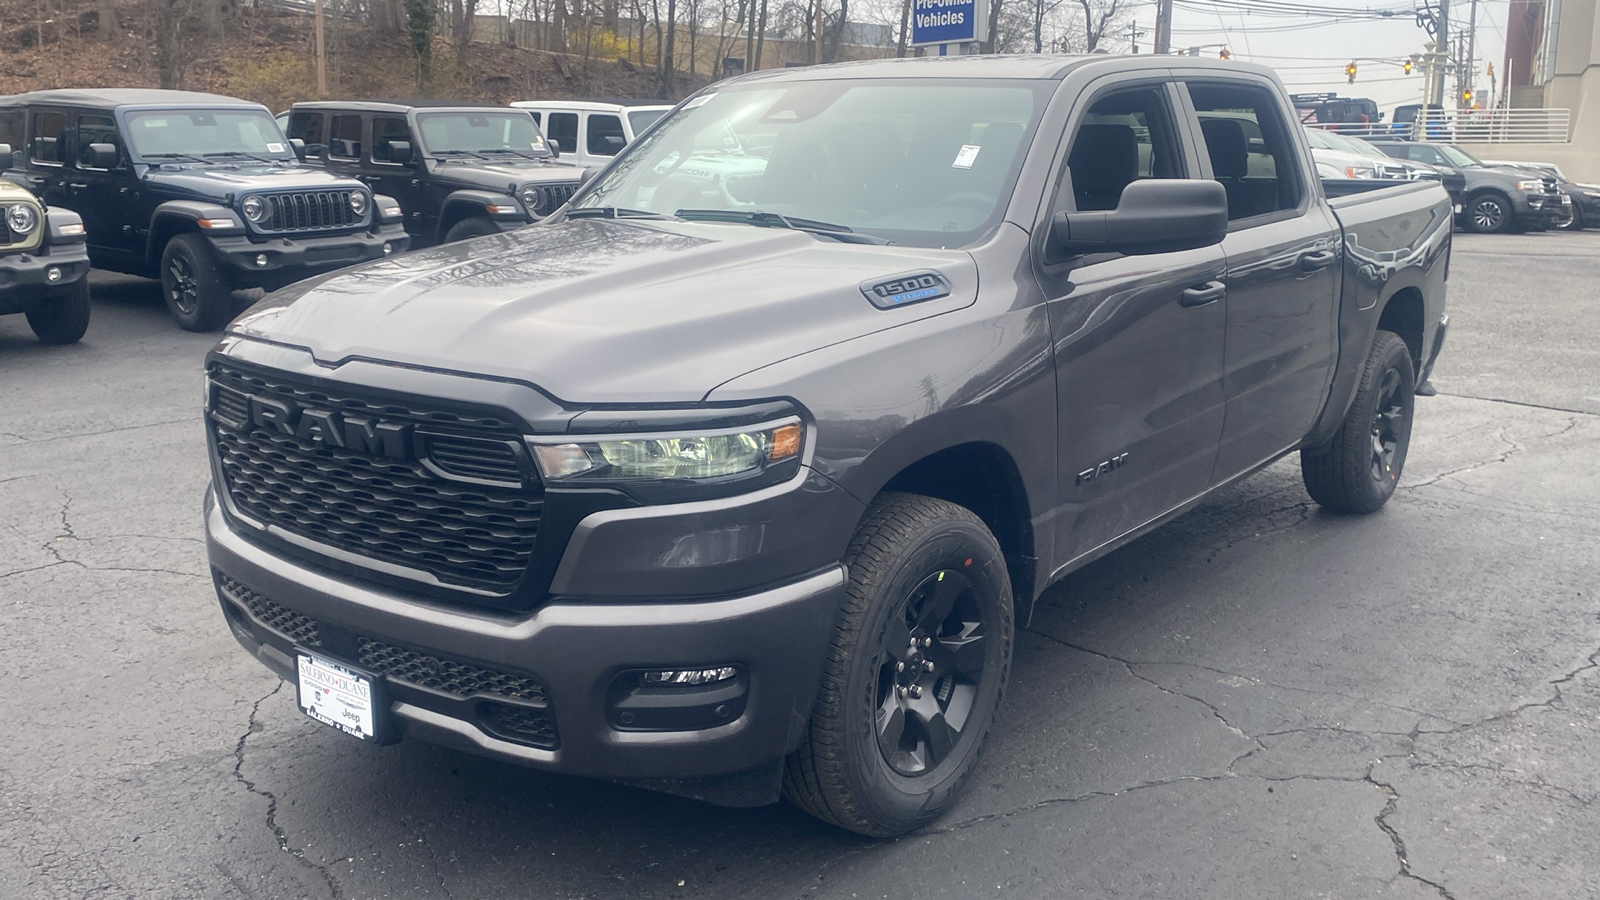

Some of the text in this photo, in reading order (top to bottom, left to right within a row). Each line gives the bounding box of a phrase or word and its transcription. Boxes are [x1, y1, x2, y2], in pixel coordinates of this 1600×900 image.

[916, 11, 964, 28] Vehicles
[875, 276, 936, 296] 1500
[249, 395, 417, 460] RAM
[1075, 452, 1130, 487] RAM
[300, 663, 335, 686] SALERNO
[338, 680, 369, 699] DUANE
[342, 708, 361, 723] Jeep
